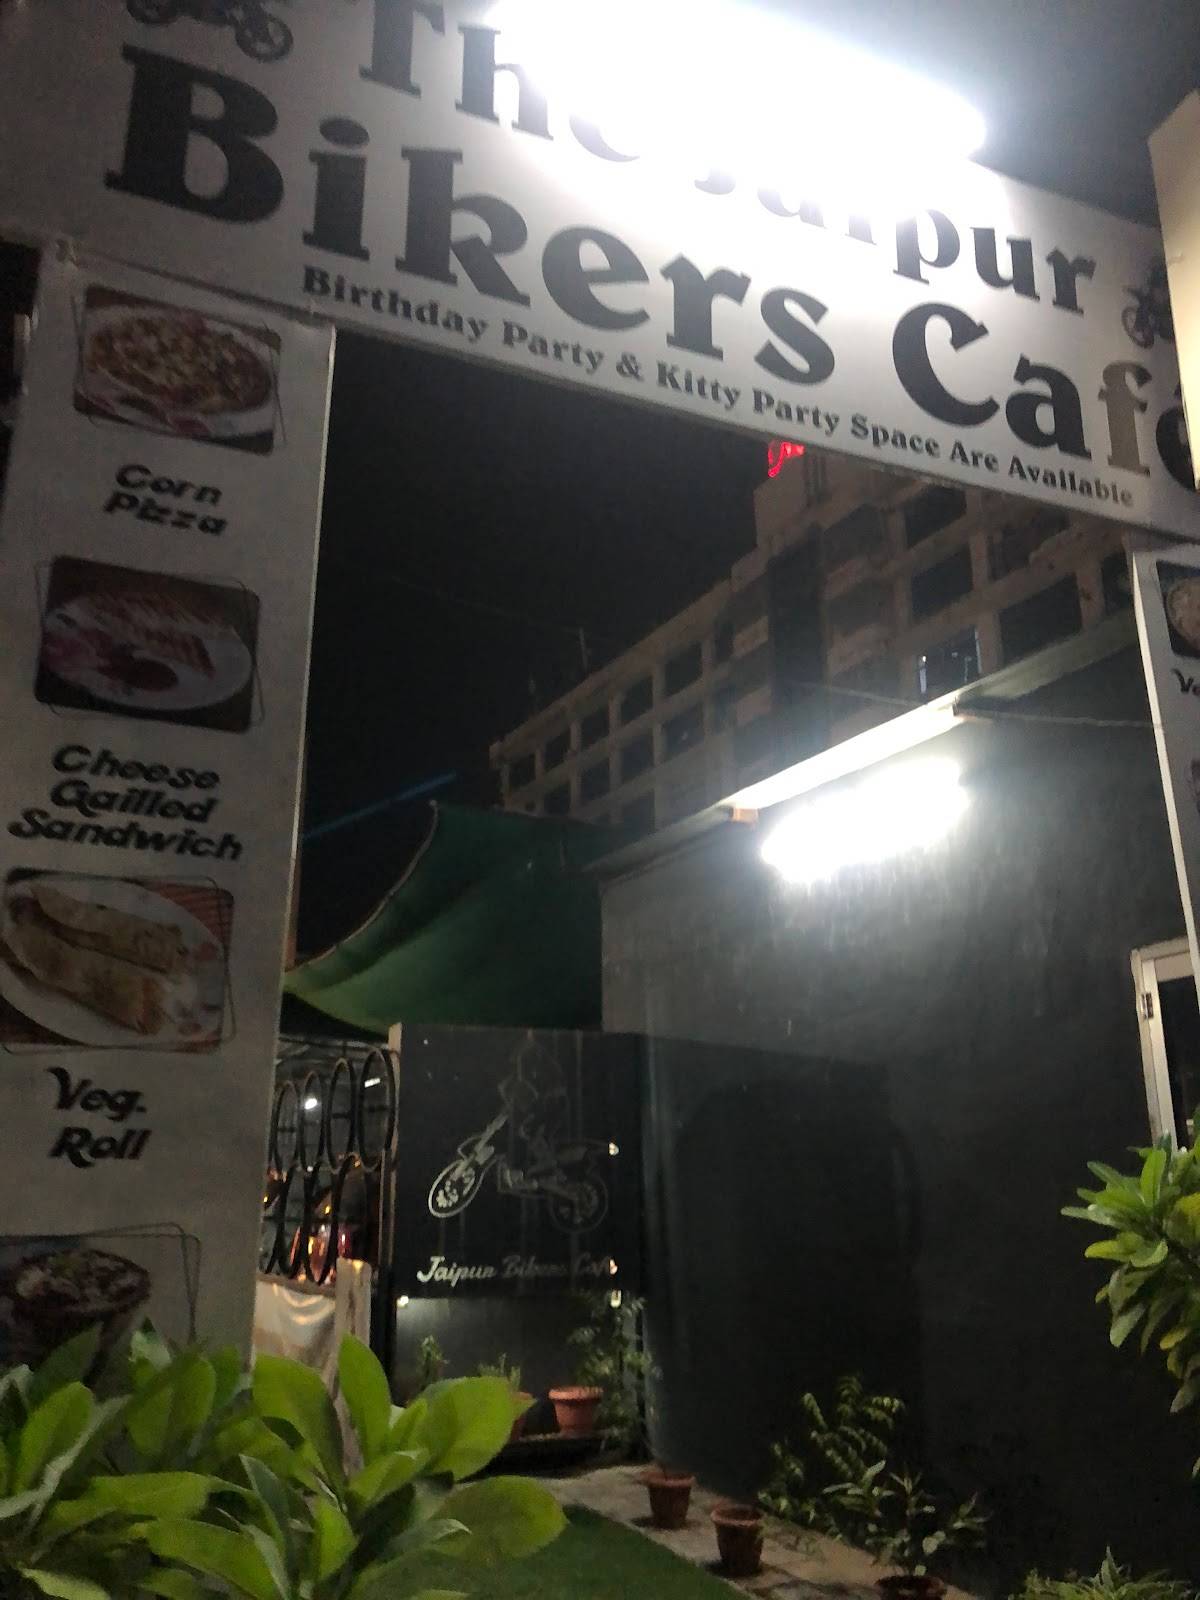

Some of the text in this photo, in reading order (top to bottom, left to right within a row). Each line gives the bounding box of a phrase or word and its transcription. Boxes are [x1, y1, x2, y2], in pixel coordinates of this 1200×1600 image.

[104, 44, 836, 386] Bikers
[693, 166, 1097, 316] pur
[303, 264, 489, 343] Birthday
[502, 320, 604, 375] Party
[615, 352, 645, 382] &
[656, 359, 741, 409] Kitty
[752, 387, 840, 437] Party
[850, 414, 941, 460] Space
[949, 439, 1000, 473] Are
[1007, 454, 1135, 508] Available
[114, 463, 223, 507] Corn
[104, 491, 228, 536] Pizza
[51, 743, 220, 791] Cheese
[6, 807, 243, 862] Sandwich
[46, 1066, 148, 1123] Veg.
[47, 1126, 152, 1170] Roll
